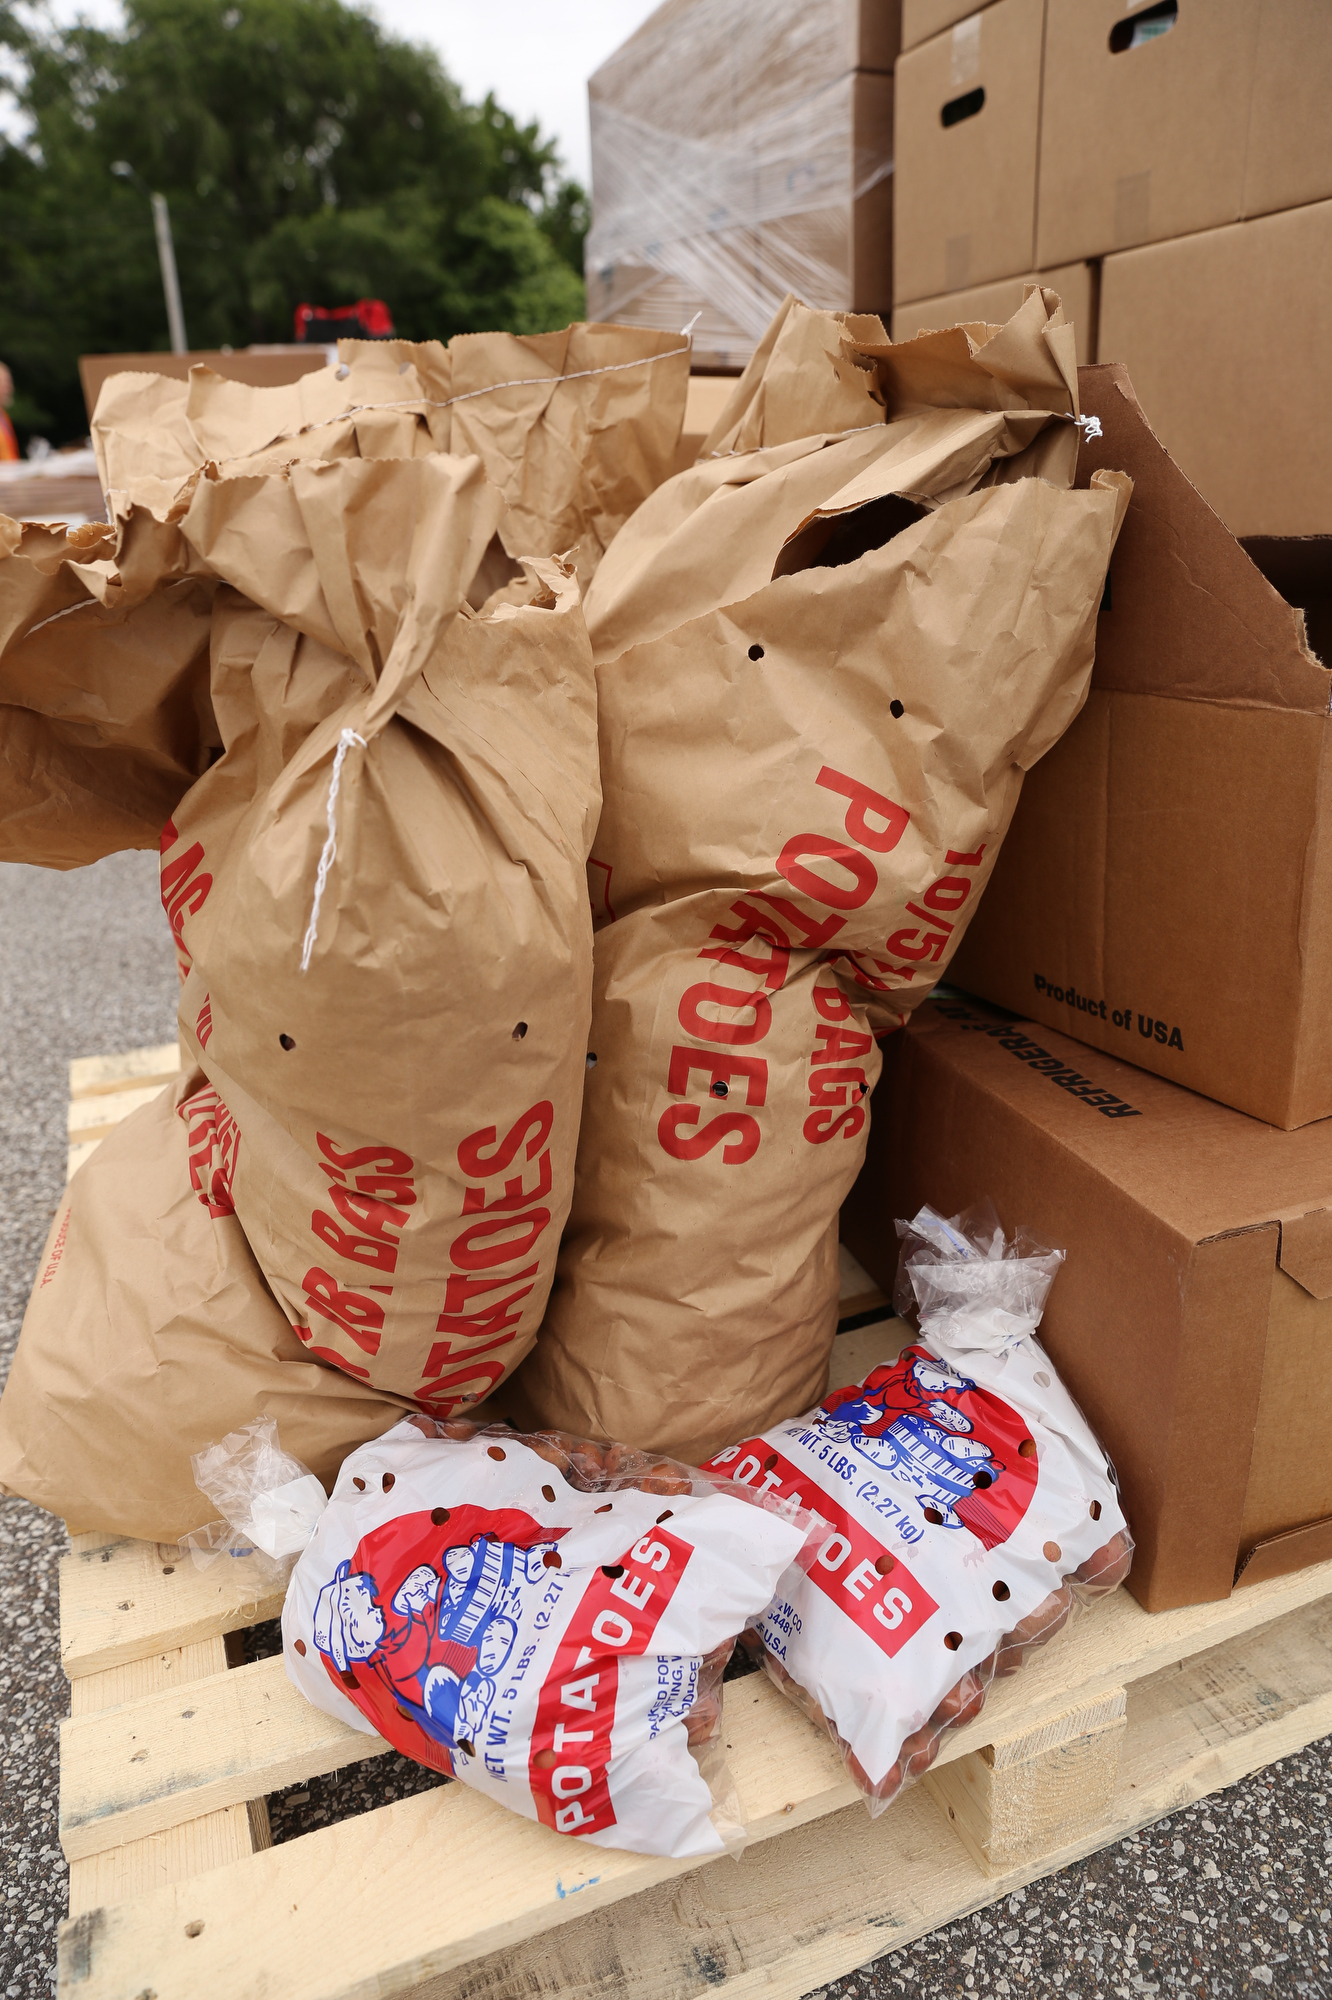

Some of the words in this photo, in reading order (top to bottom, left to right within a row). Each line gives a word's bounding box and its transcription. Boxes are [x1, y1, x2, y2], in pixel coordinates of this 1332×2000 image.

[887, 843, 987, 962] 10/5
[802, 986, 873, 1145] BAGS
[1034, 973, 1107, 1020] Product
[1112, 1009, 1133, 1031] of
[1138, 1014, 1184, 1051] USA
[414, 1100, 554, 1418] OTATOES
[711, 1446, 913, 1630] POTATOES
[798, 1430, 822, 1453] WT.
[818, 1445, 832, 1460] 5
[827, 1451, 857, 1485] LBS.
[856, 1481, 901, 1518] (2.27
[895, 1515, 925, 1544] kg)
[486, 1710, 512, 1746] WT.
[502, 1688, 518, 1700] 5
[511, 1637, 540, 1681] LBS.
[533, 1582, 564, 1630] (2.27
[672, 1661, 700, 1717] PODUCE
